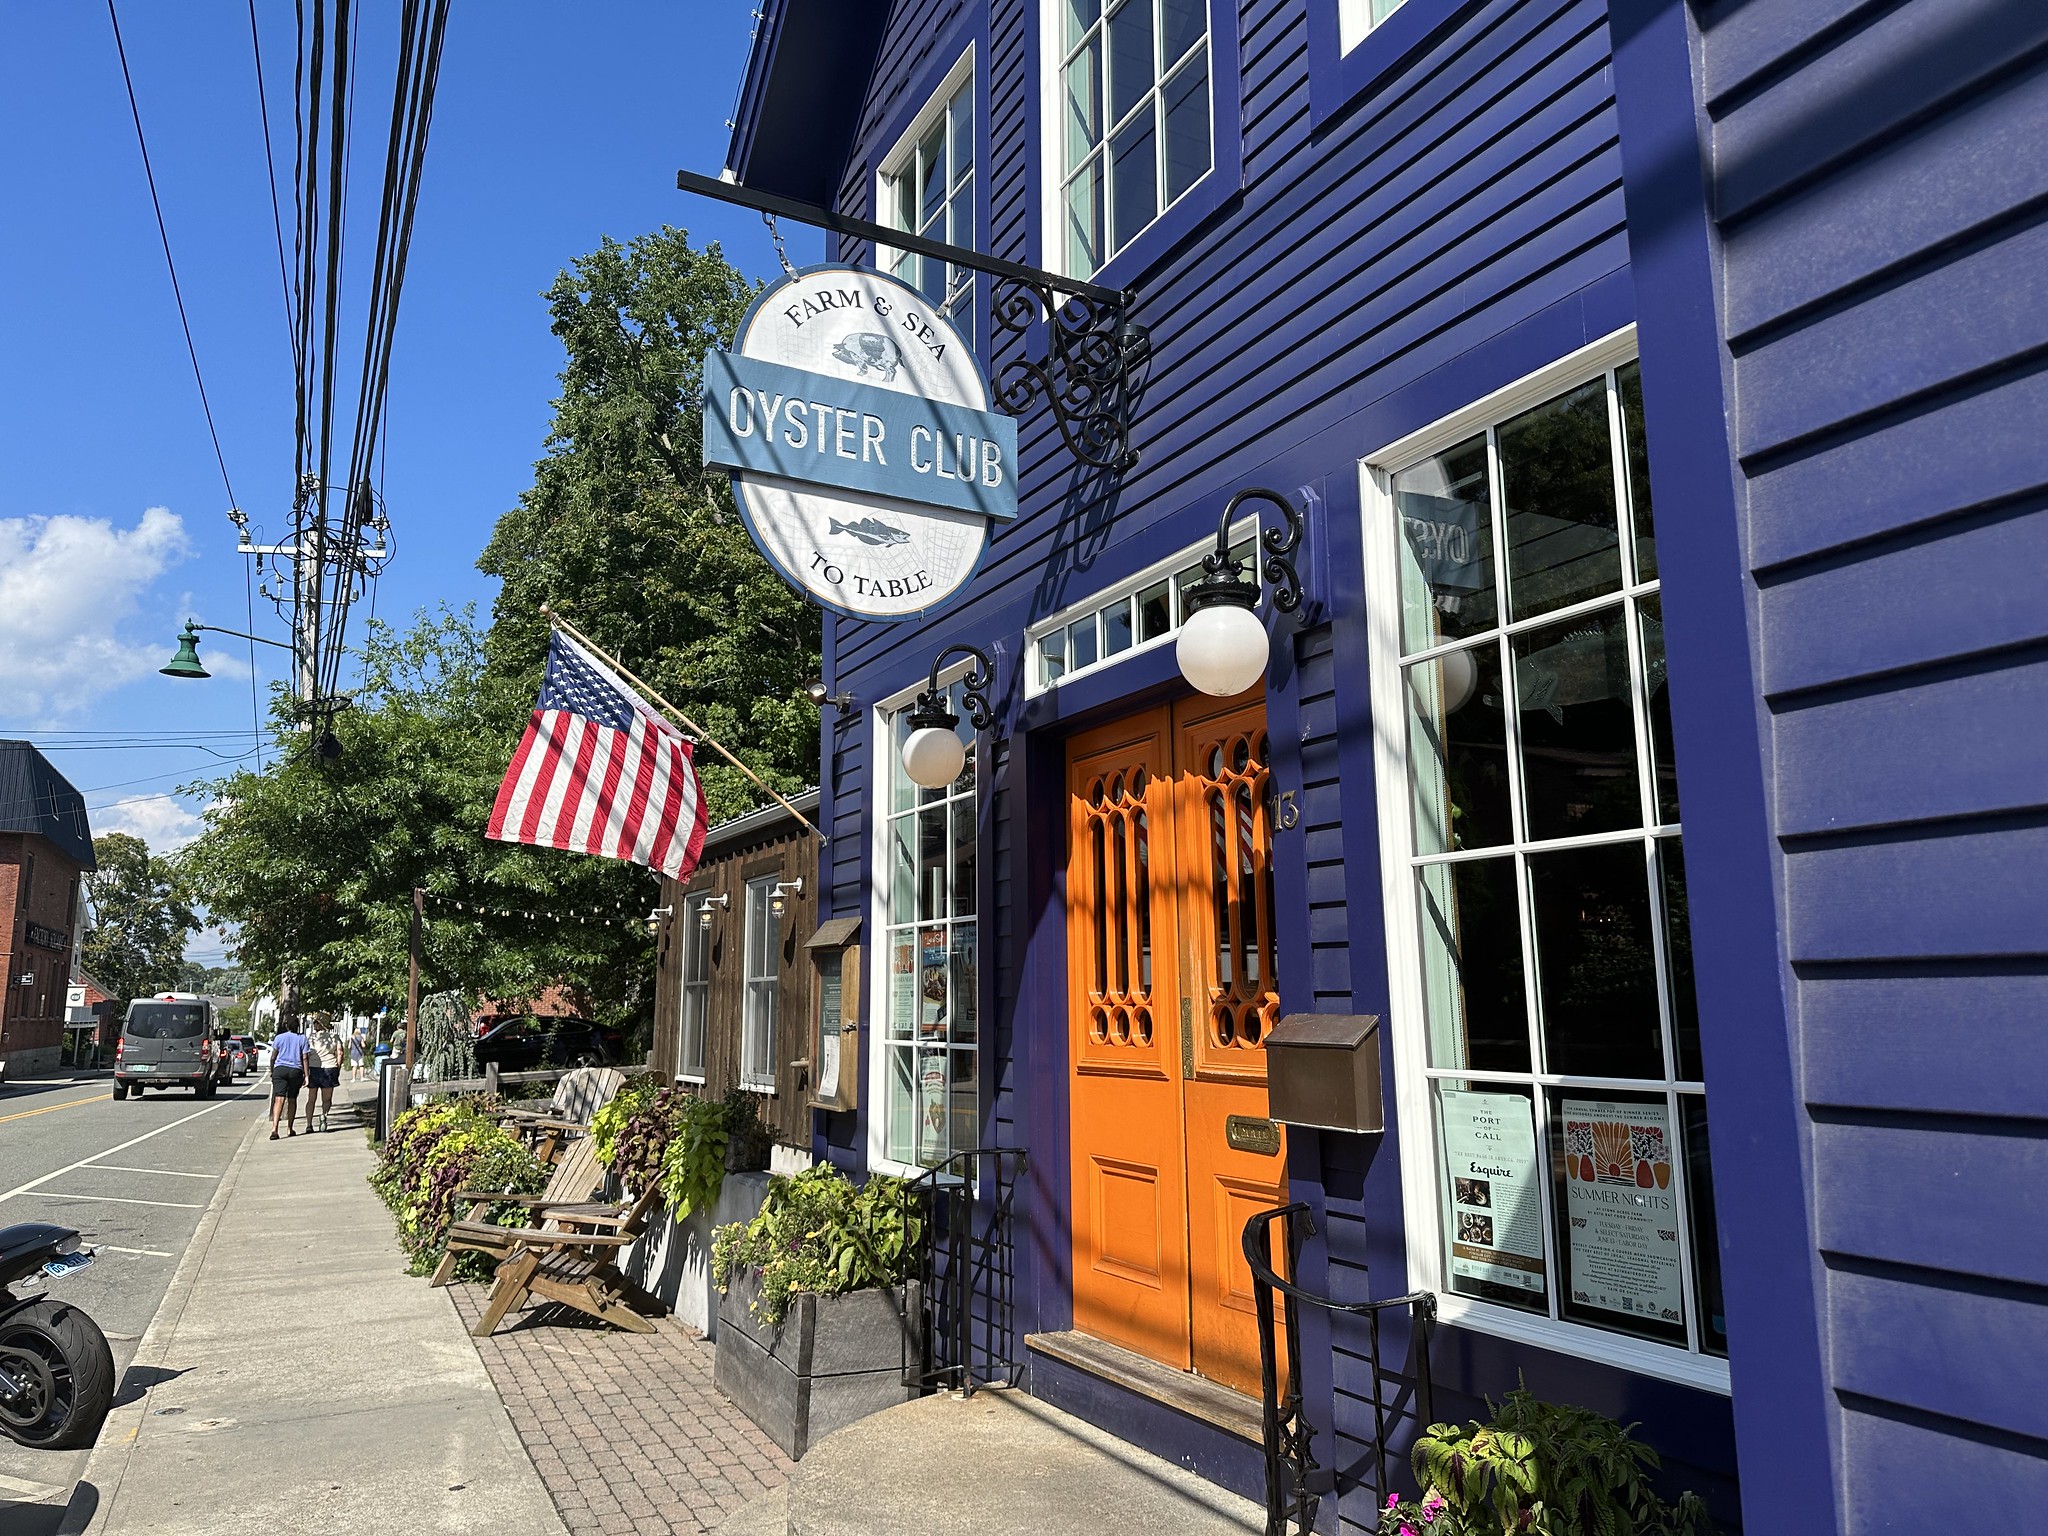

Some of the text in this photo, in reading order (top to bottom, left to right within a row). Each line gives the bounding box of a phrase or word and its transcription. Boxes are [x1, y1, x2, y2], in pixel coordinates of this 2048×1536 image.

[783, 288, 947, 364] FARM & SEA
[729, 385, 1003, 488] OYSTER CLUB
[810, 551, 934, 598] TO TABLE
[1271, 790, 1299, 831] 13
[1473, 1116, 1501, 1125] PORT
[1475, 1132, 1501, 1140] CALL
[1470, 1162, 1513, 1178] Esquire
[1571, 1186, 1669, 1210] SUMMER NIGHTS
